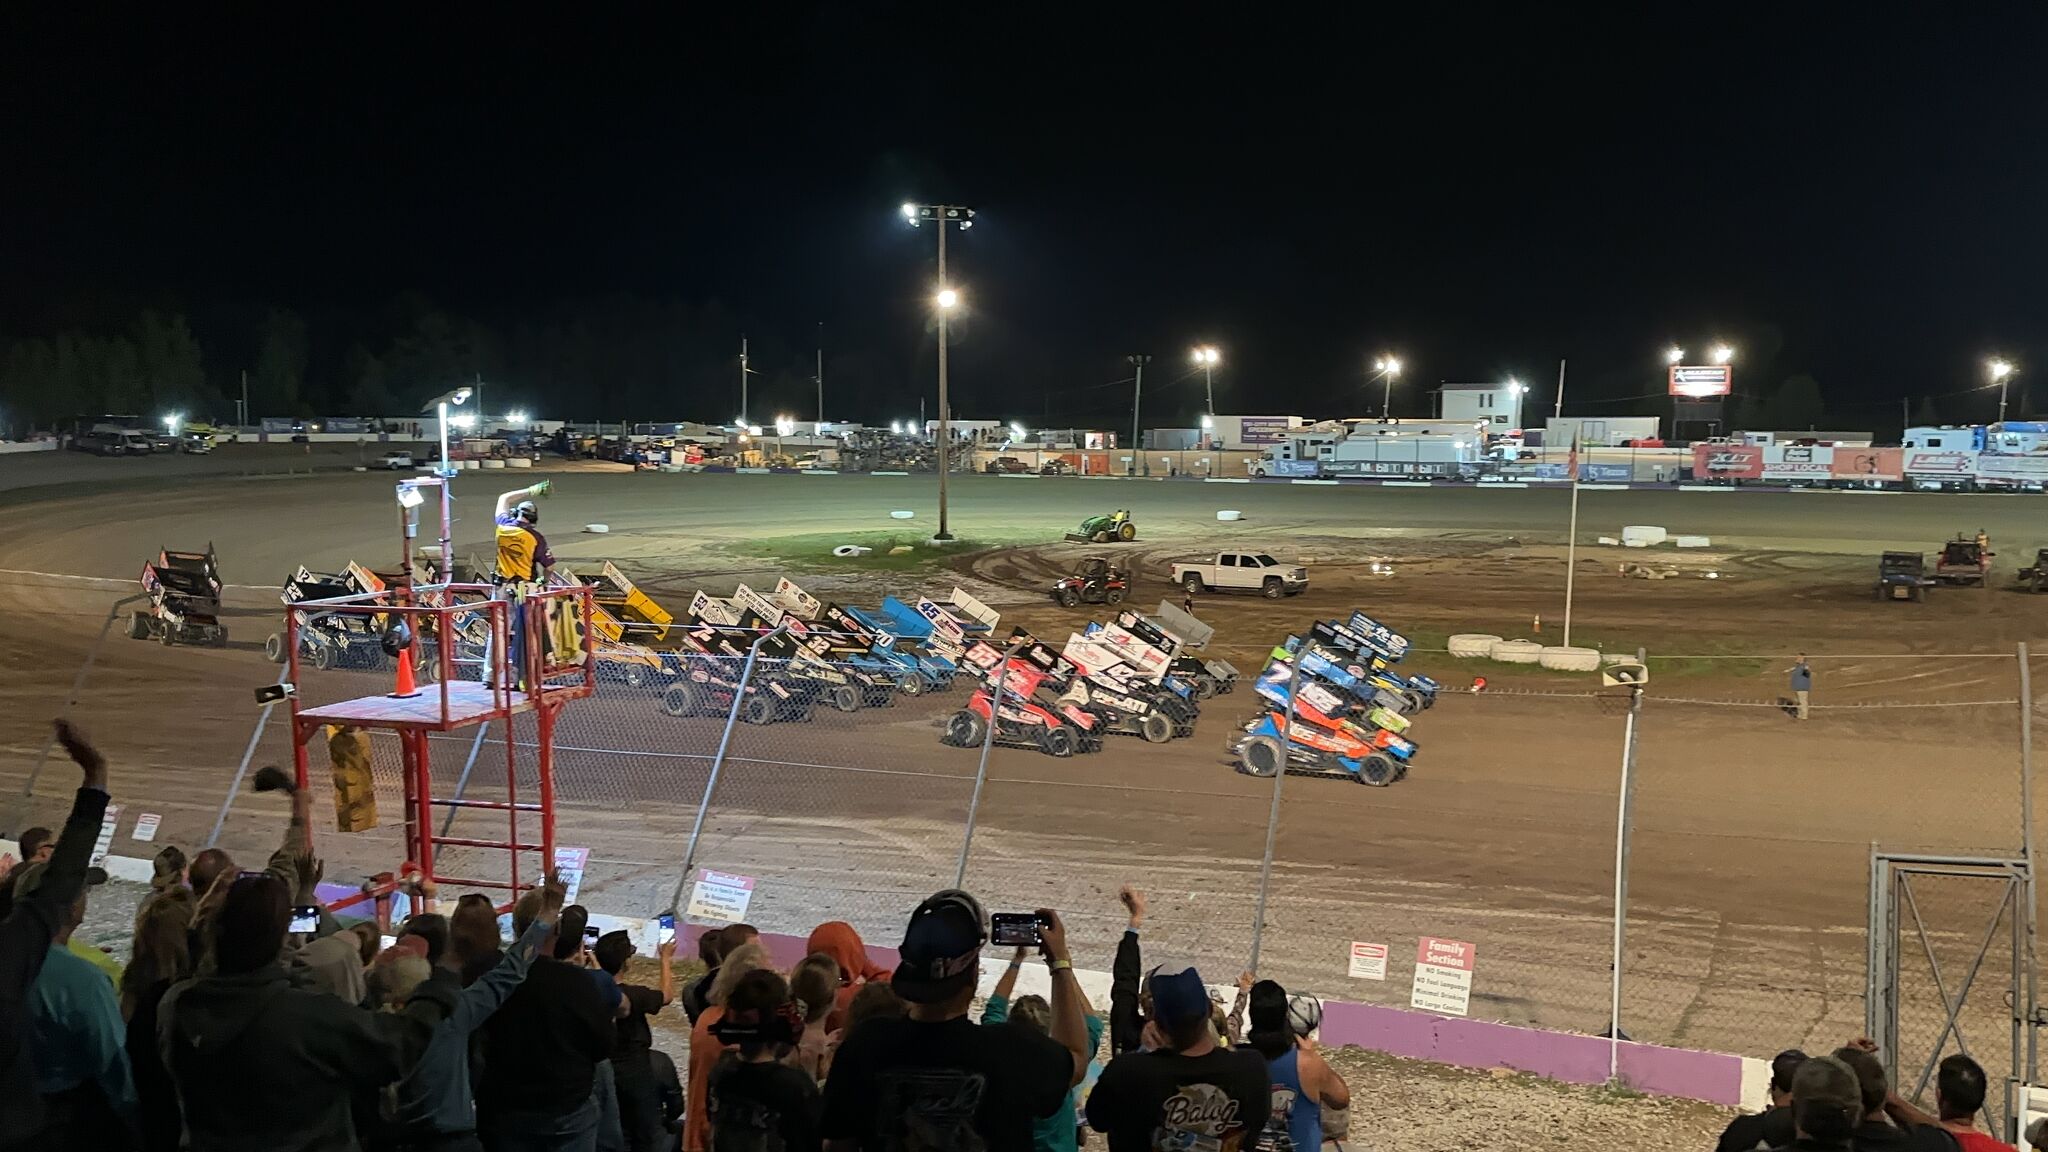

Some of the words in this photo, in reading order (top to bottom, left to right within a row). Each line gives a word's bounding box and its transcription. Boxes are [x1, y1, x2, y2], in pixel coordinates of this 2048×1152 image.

[1764, 464, 1793, 472] SHOP
[1795, 464, 1829, 472] LOCAL
[920, 602, 941, 620] 45
[1428, 941, 1465, 956] Family
[1426, 952, 1464, 967] Section
[1436, 969, 1461, 979] Smoking
[1426, 978, 1439, 986] Foul
[1440, 980, 1468, 991] Language
[1415, 987, 1440, 997] Minimal
[1440, 991, 1466, 1003] Drinking
[1425, 1000, 1441, 1009] Large
[1442, 1003, 1464, 1013] Coolers
[1163, 1095, 1244, 1135] Balog
